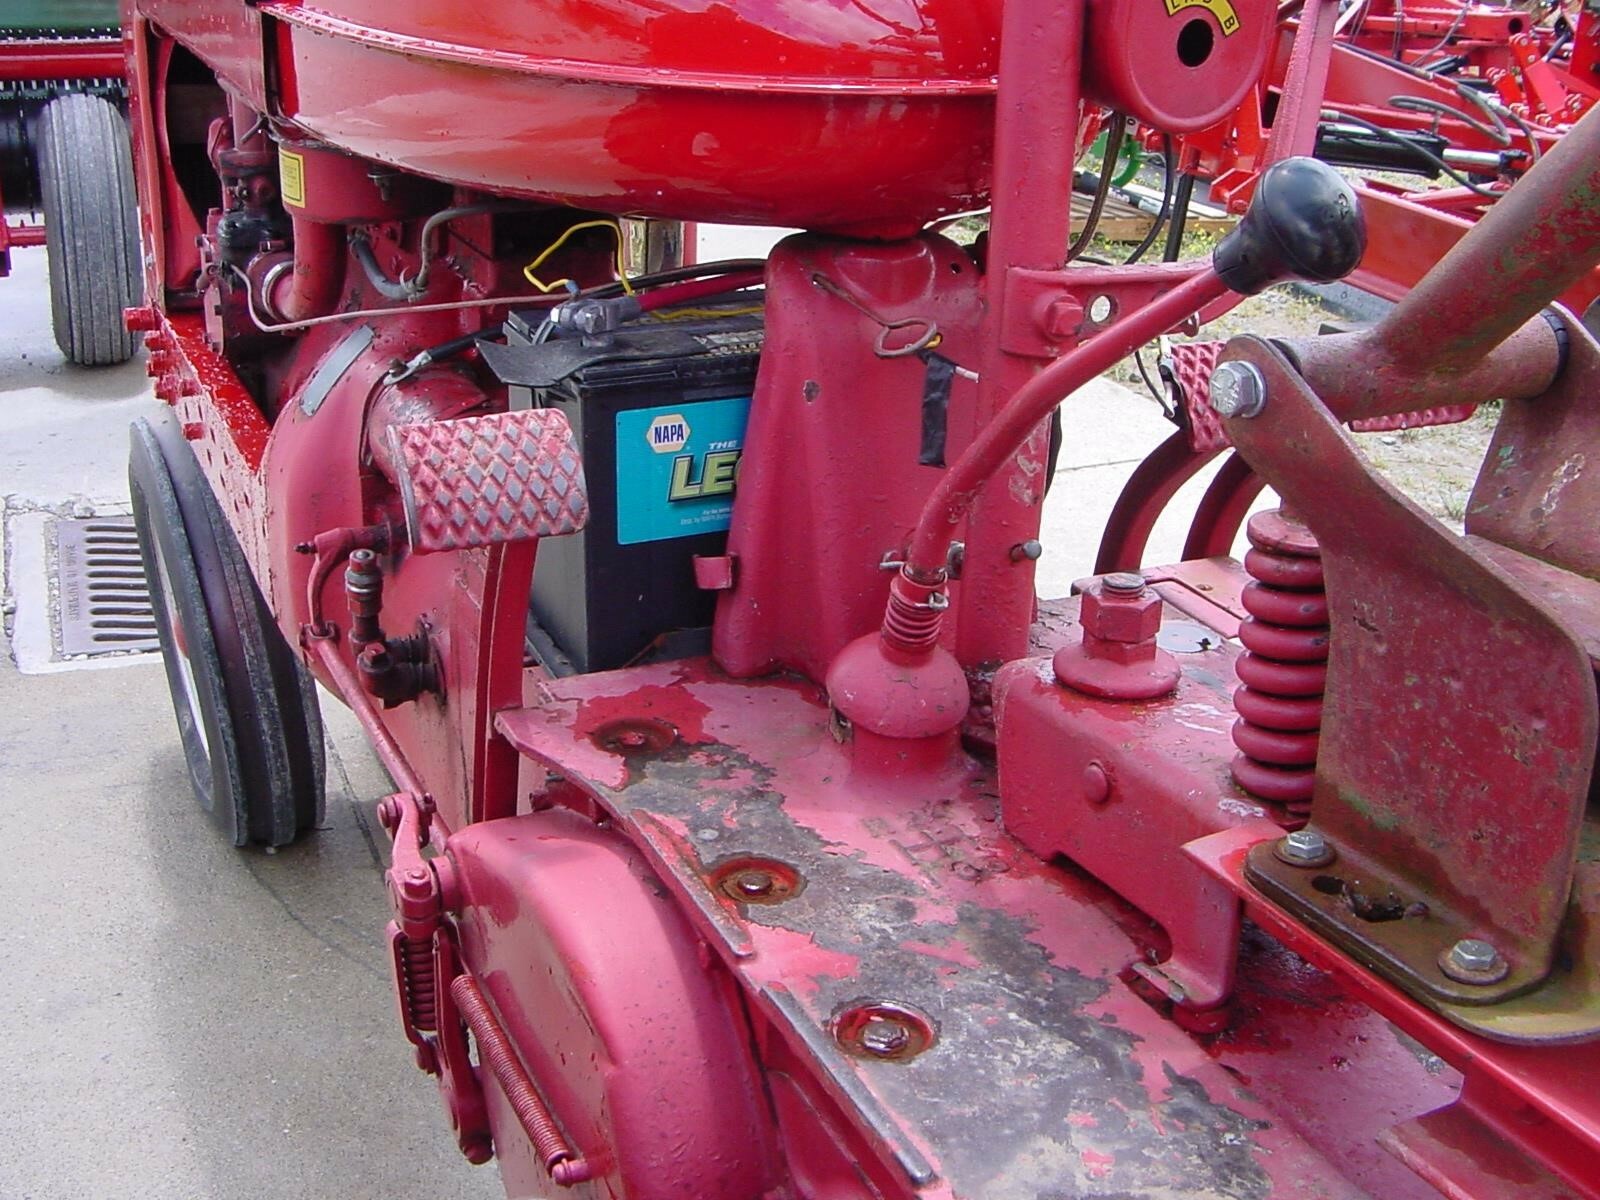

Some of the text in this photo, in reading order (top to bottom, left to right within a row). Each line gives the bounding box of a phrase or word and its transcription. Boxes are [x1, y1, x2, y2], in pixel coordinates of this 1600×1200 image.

[1223, 15, 1235, 30] B
[654, 423, 685, 444] NAPA
[709, 439, 738, 450] THE
[666, 449, 744, 504] LE
